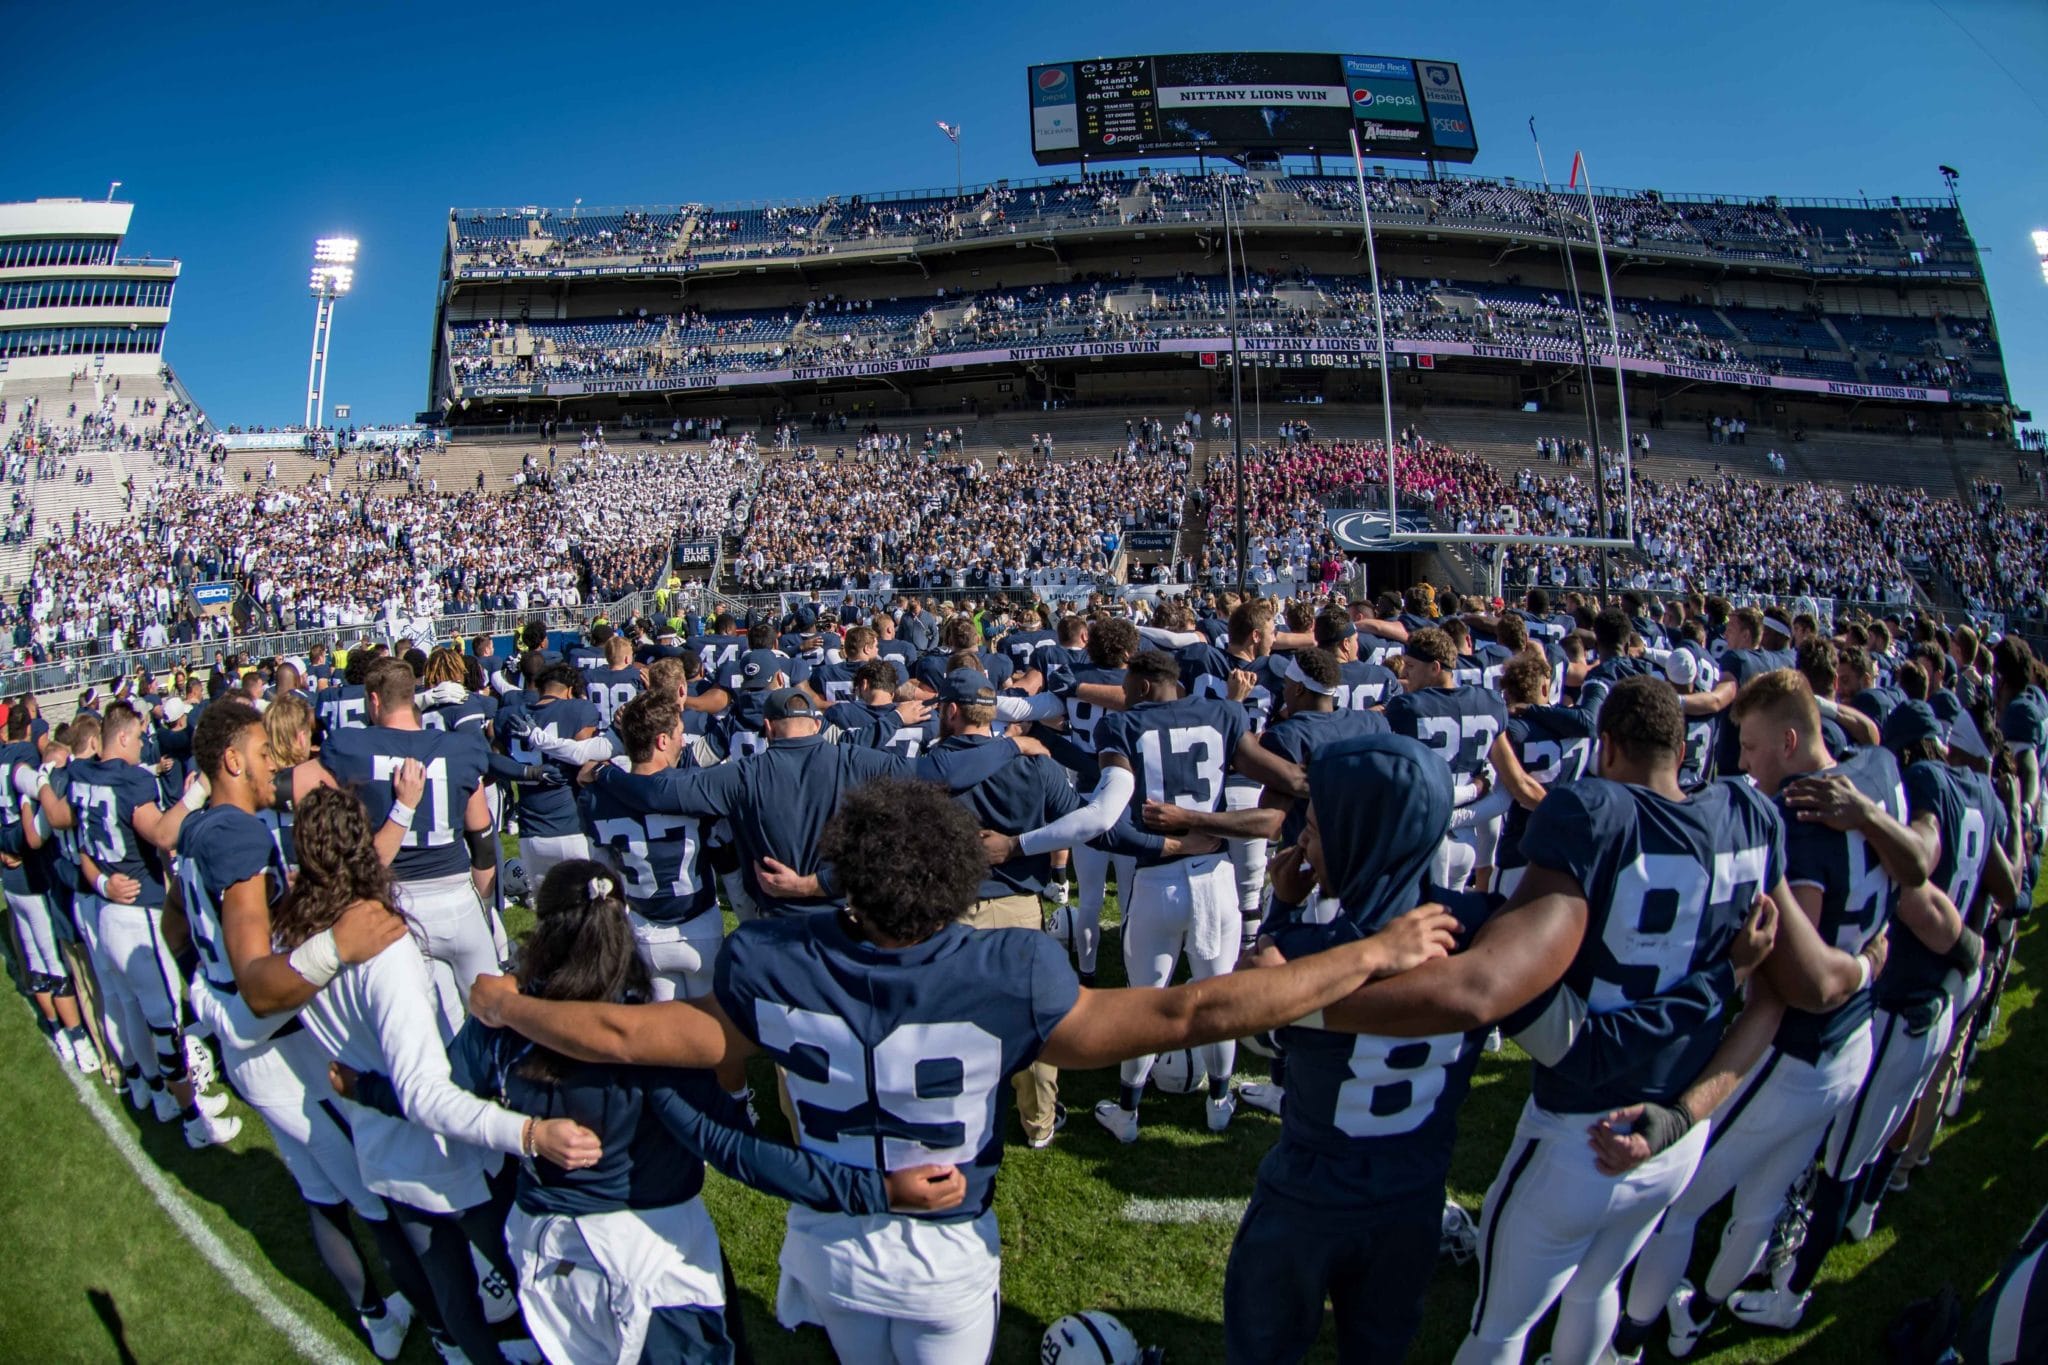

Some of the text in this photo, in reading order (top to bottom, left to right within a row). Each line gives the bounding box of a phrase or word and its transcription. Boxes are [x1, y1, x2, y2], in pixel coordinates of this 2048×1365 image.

[1099, 60, 1145, 72] 35 7
[1347, 60, 1385, 71] Plymouth
[1386, 64, 1407, 72] Rock
[1094, 75, 1139, 86] 3rd and 15
[1086, 89, 1150, 100] 4th QTR 0:00
[1180, 90, 1327, 101] NITTANY LIONS WIN
[1375, 94, 1417, 107] pepsi
[1117, 133, 1144, 144] pepsi
[1010, 341, 1160, 360] NITTANY LIONS WIN
[1244, 338, 1394, 351] NITTANY LIONS WN
[1278, 354, 1284, 363] 3
[1292, 354, 1302, 364] 15
[1336, 354, 1348, 364] 43
[1352, 354, 1359, 364] 4
[1472, 344, 1532, 360] NITTANY
[1536, 349, 1574, 363] LIONS
[1311, 354, 1334, 366] 0:00
[1403, 356, 1410, 367] 7
[793, 358, 930, 380] NITTANY LIONS WIN
[1664, 364, 1772, 386] NITTANY LIONS WIN
[583, 376, 718, 393] NITTANY LIONS WIN
[1828, 382, 1927, 400] NITTANY LIONS WIN
[247, 434, 302, 446] PEPSI ZONE
[684, 546, 710, 555] BLUE
[683, 554, 711, 563] BAND
[196, 588, 229, 600] GEICO
[1135, 725, 1226, 813] 13
[593, 813, 703, 900] 37
[754, 997, 1002, 1172] 29
[1333, 1031, 1465, 1139] 8
